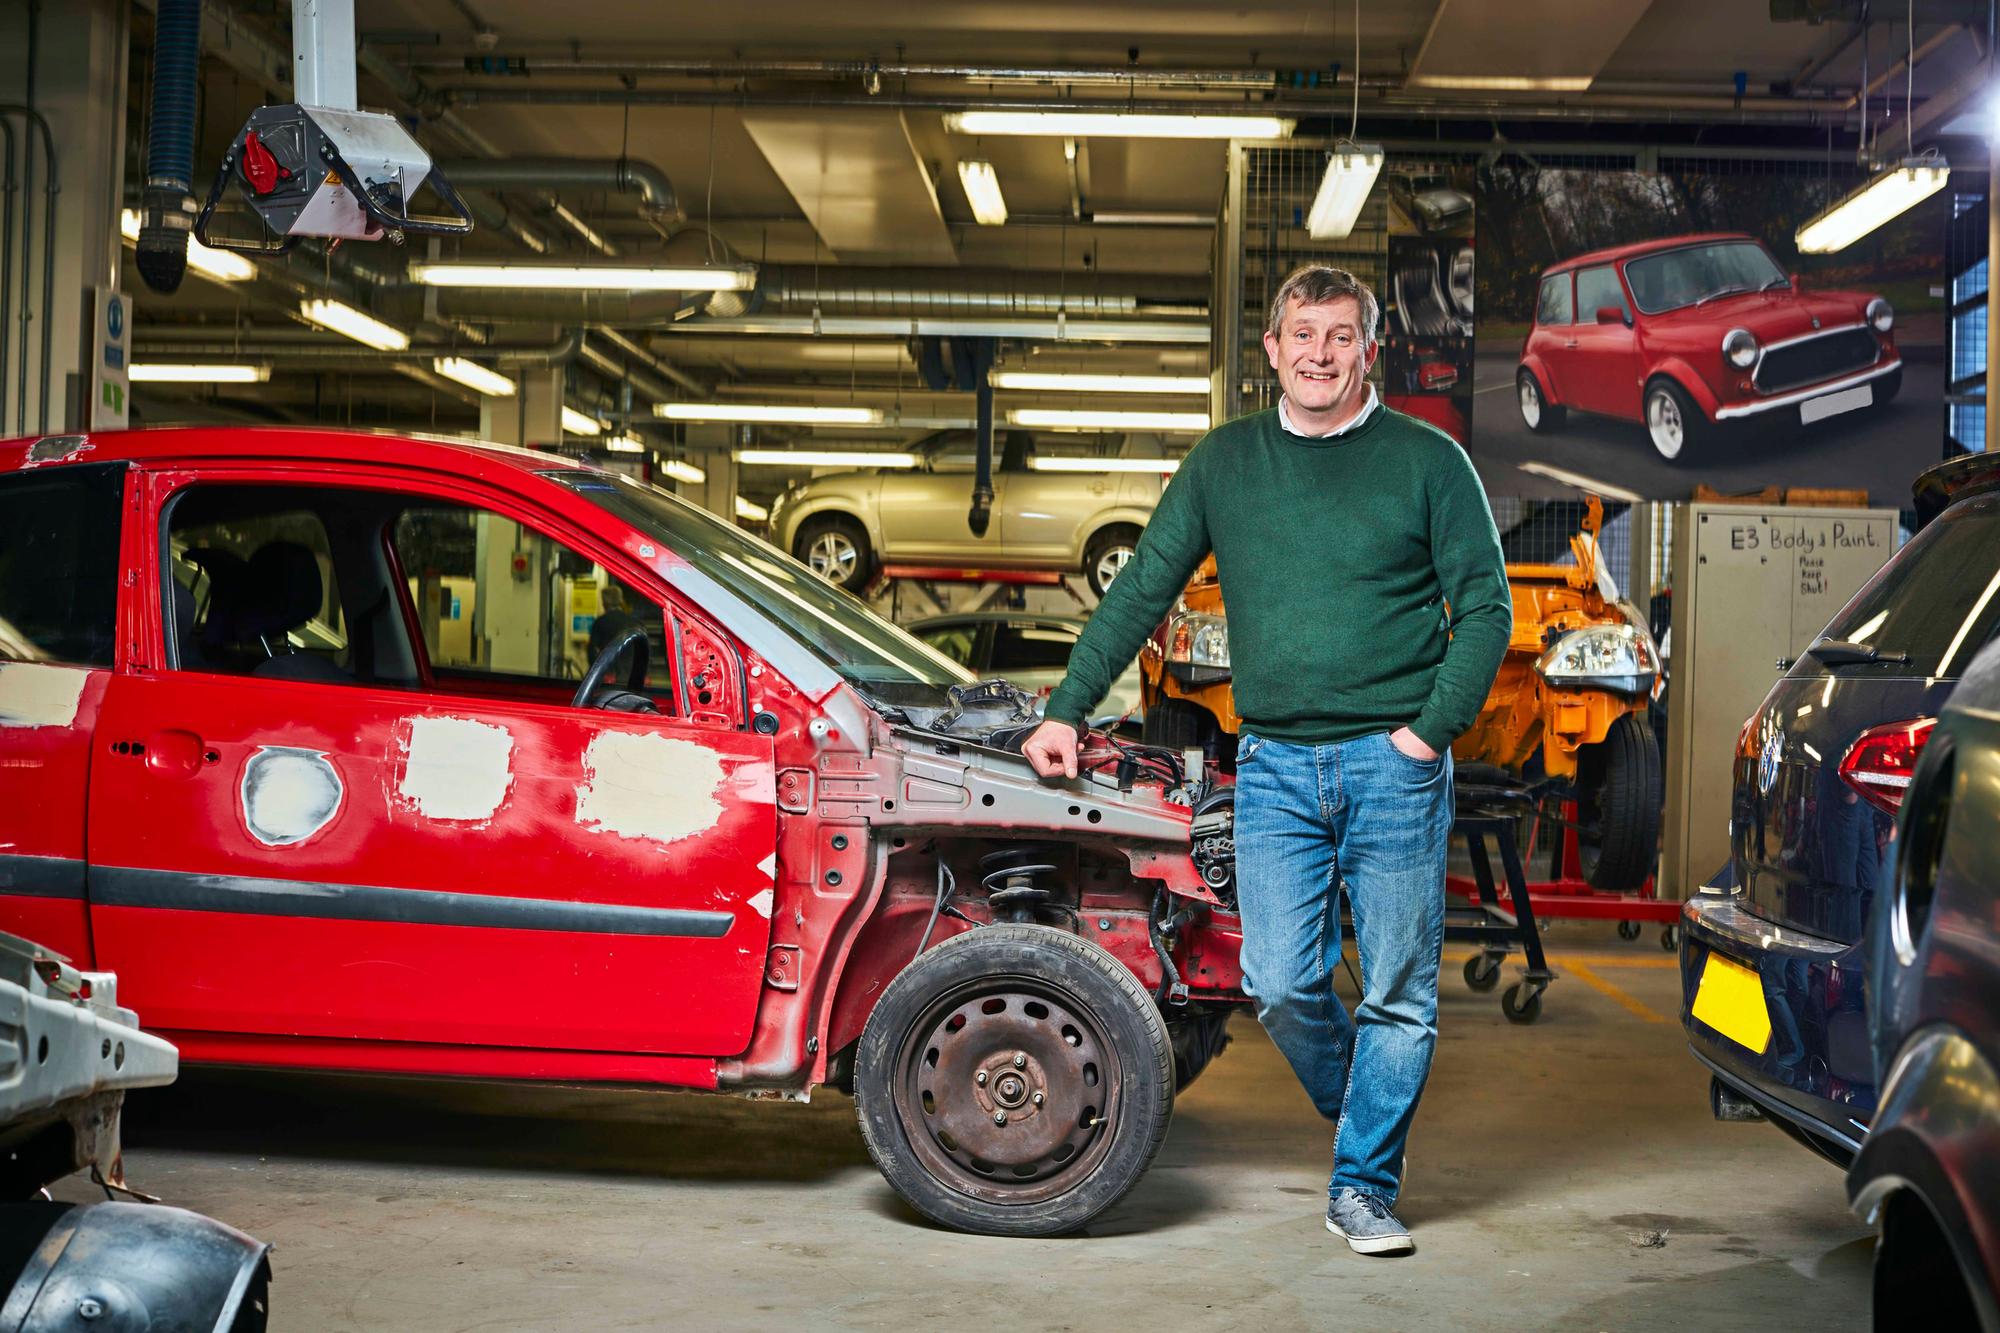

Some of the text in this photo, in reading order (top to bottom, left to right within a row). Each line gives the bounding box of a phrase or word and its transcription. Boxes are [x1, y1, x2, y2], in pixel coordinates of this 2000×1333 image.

[1731, 526, 1760, 550] E3
[1770, 528, 1814, 553] Body
[1833, 521, 1880, 549] Paint.
